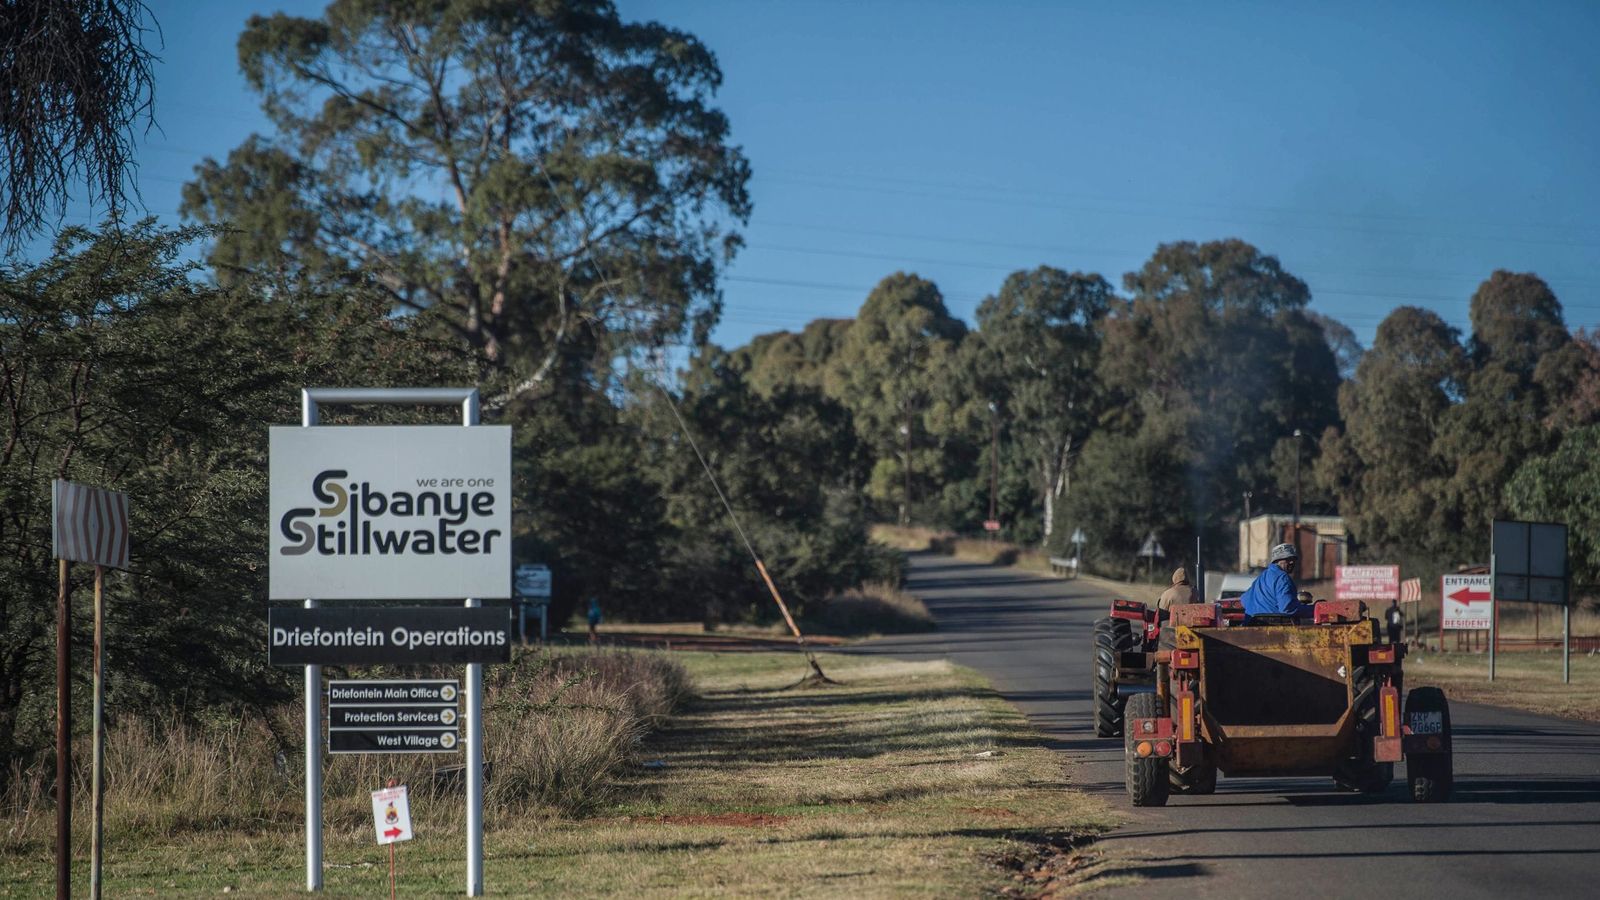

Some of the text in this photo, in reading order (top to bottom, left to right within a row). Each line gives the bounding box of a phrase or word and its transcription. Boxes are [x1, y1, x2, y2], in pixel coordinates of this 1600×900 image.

[416, 478, 495, 488] we are one
[312, 469, 496, 526] Sibanye
[280, 507, 502, 556] Stillwater
[273, 626, 506, 650] Driefontein Operations
[332, 687, 439, 699] Driefontein Main Office
[344, 711, 439, 722] Protection Services
[377, 735, 439, 747] West Village
